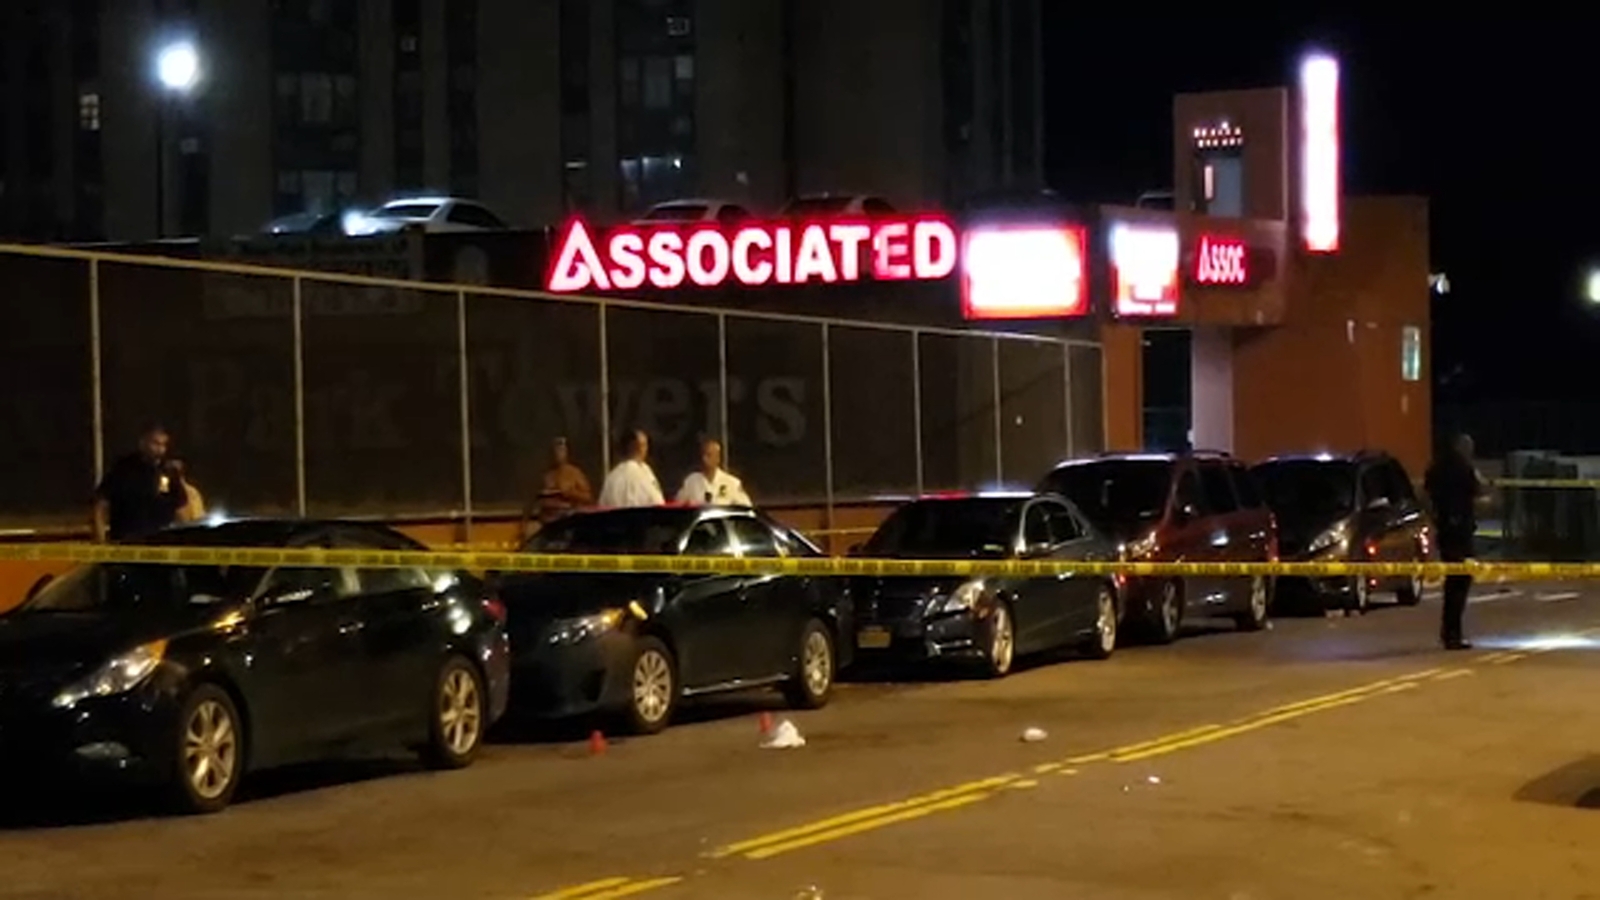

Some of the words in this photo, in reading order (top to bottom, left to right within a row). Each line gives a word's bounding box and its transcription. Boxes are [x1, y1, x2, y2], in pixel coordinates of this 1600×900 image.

[549, 219, 957, 291] ASSOCIATED
[1197, 235, 1245, 283] ASSOC
[436, 350, 807, 447] Towers
